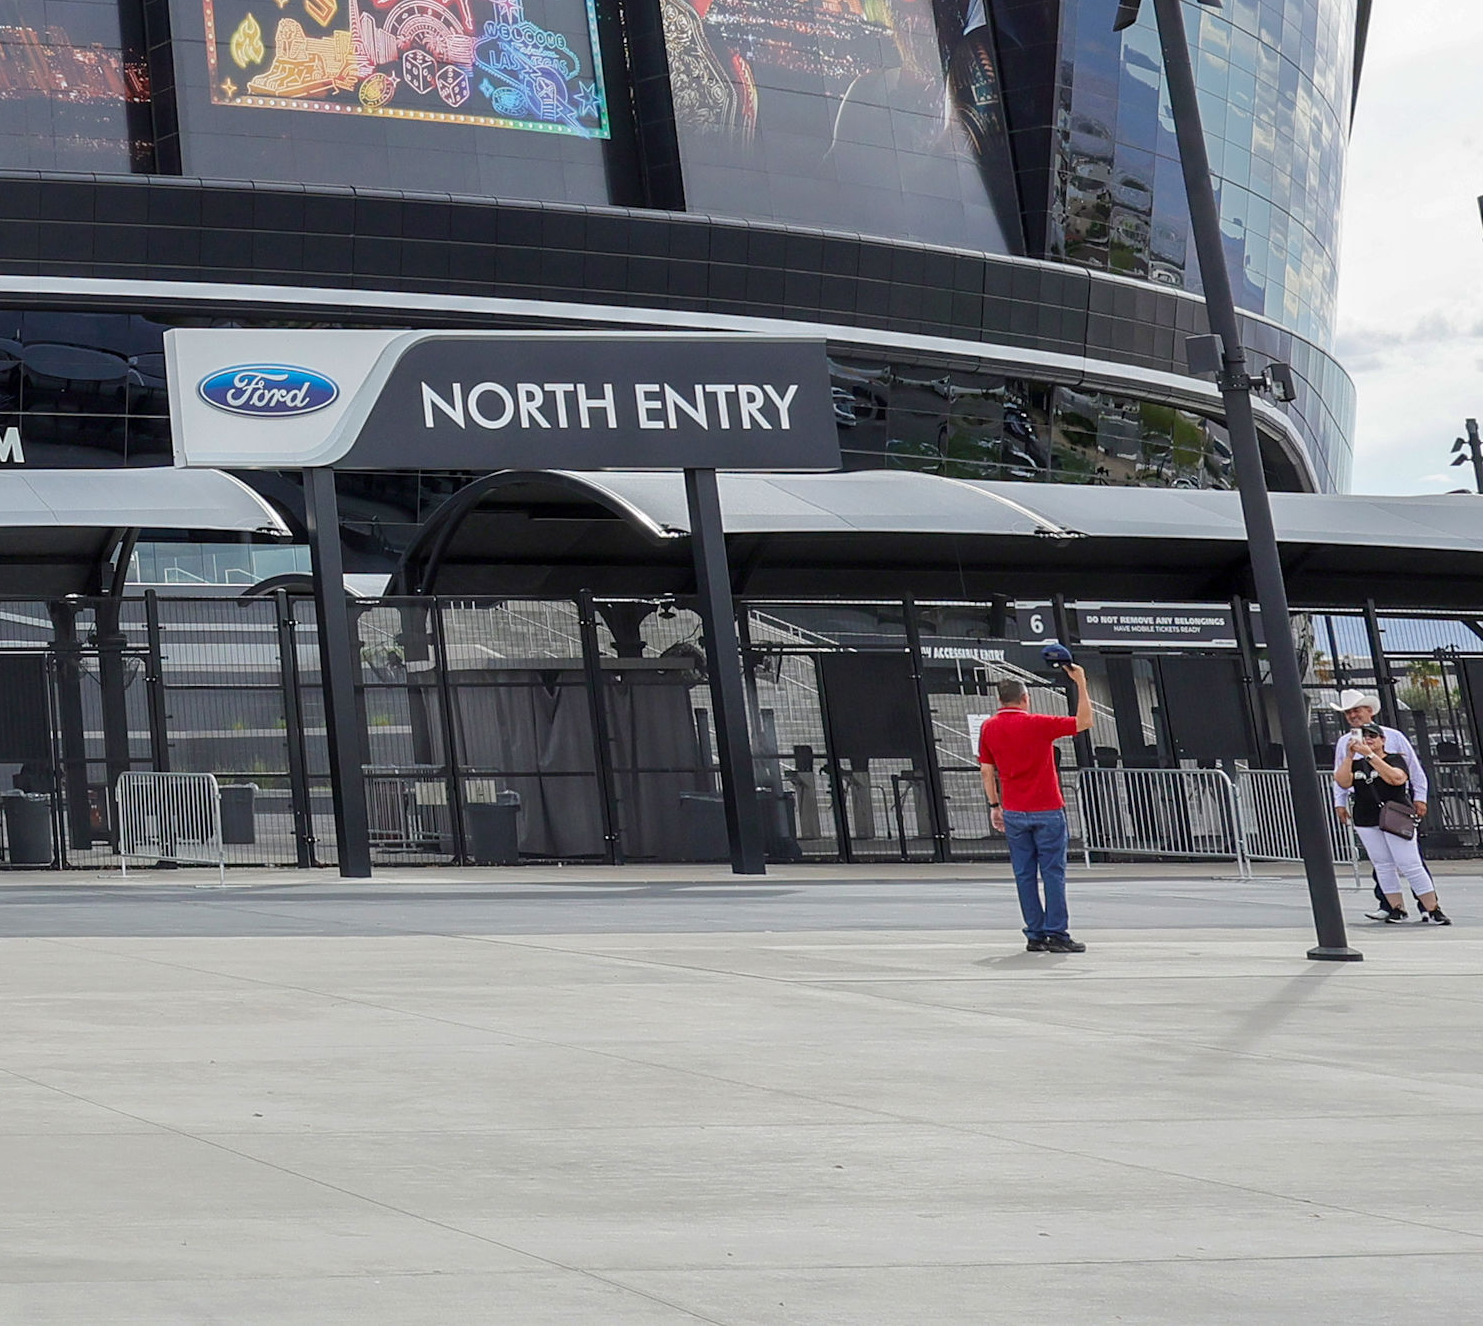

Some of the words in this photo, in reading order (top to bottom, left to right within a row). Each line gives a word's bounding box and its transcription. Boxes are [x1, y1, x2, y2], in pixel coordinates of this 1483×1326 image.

[485, 23, 566, 48] WELCOME
[226, 365, 312, 411] Ford
[421, 381, 617, 430] NORTH
[637, 382, 798, 431] ENTRY
[1030, 614, 1044, 634] 6
[1100, 616, 1118, 624] NOT
[1155, 617, 1173, 625] ANY
[1174, 618, 1225, 626] BELONGINGS
[1132, 625, 1155, 633] MOBILE
[1180, 626, 1202, 634] READY
[933, 646, 980, 659] ACCESSIBLE
